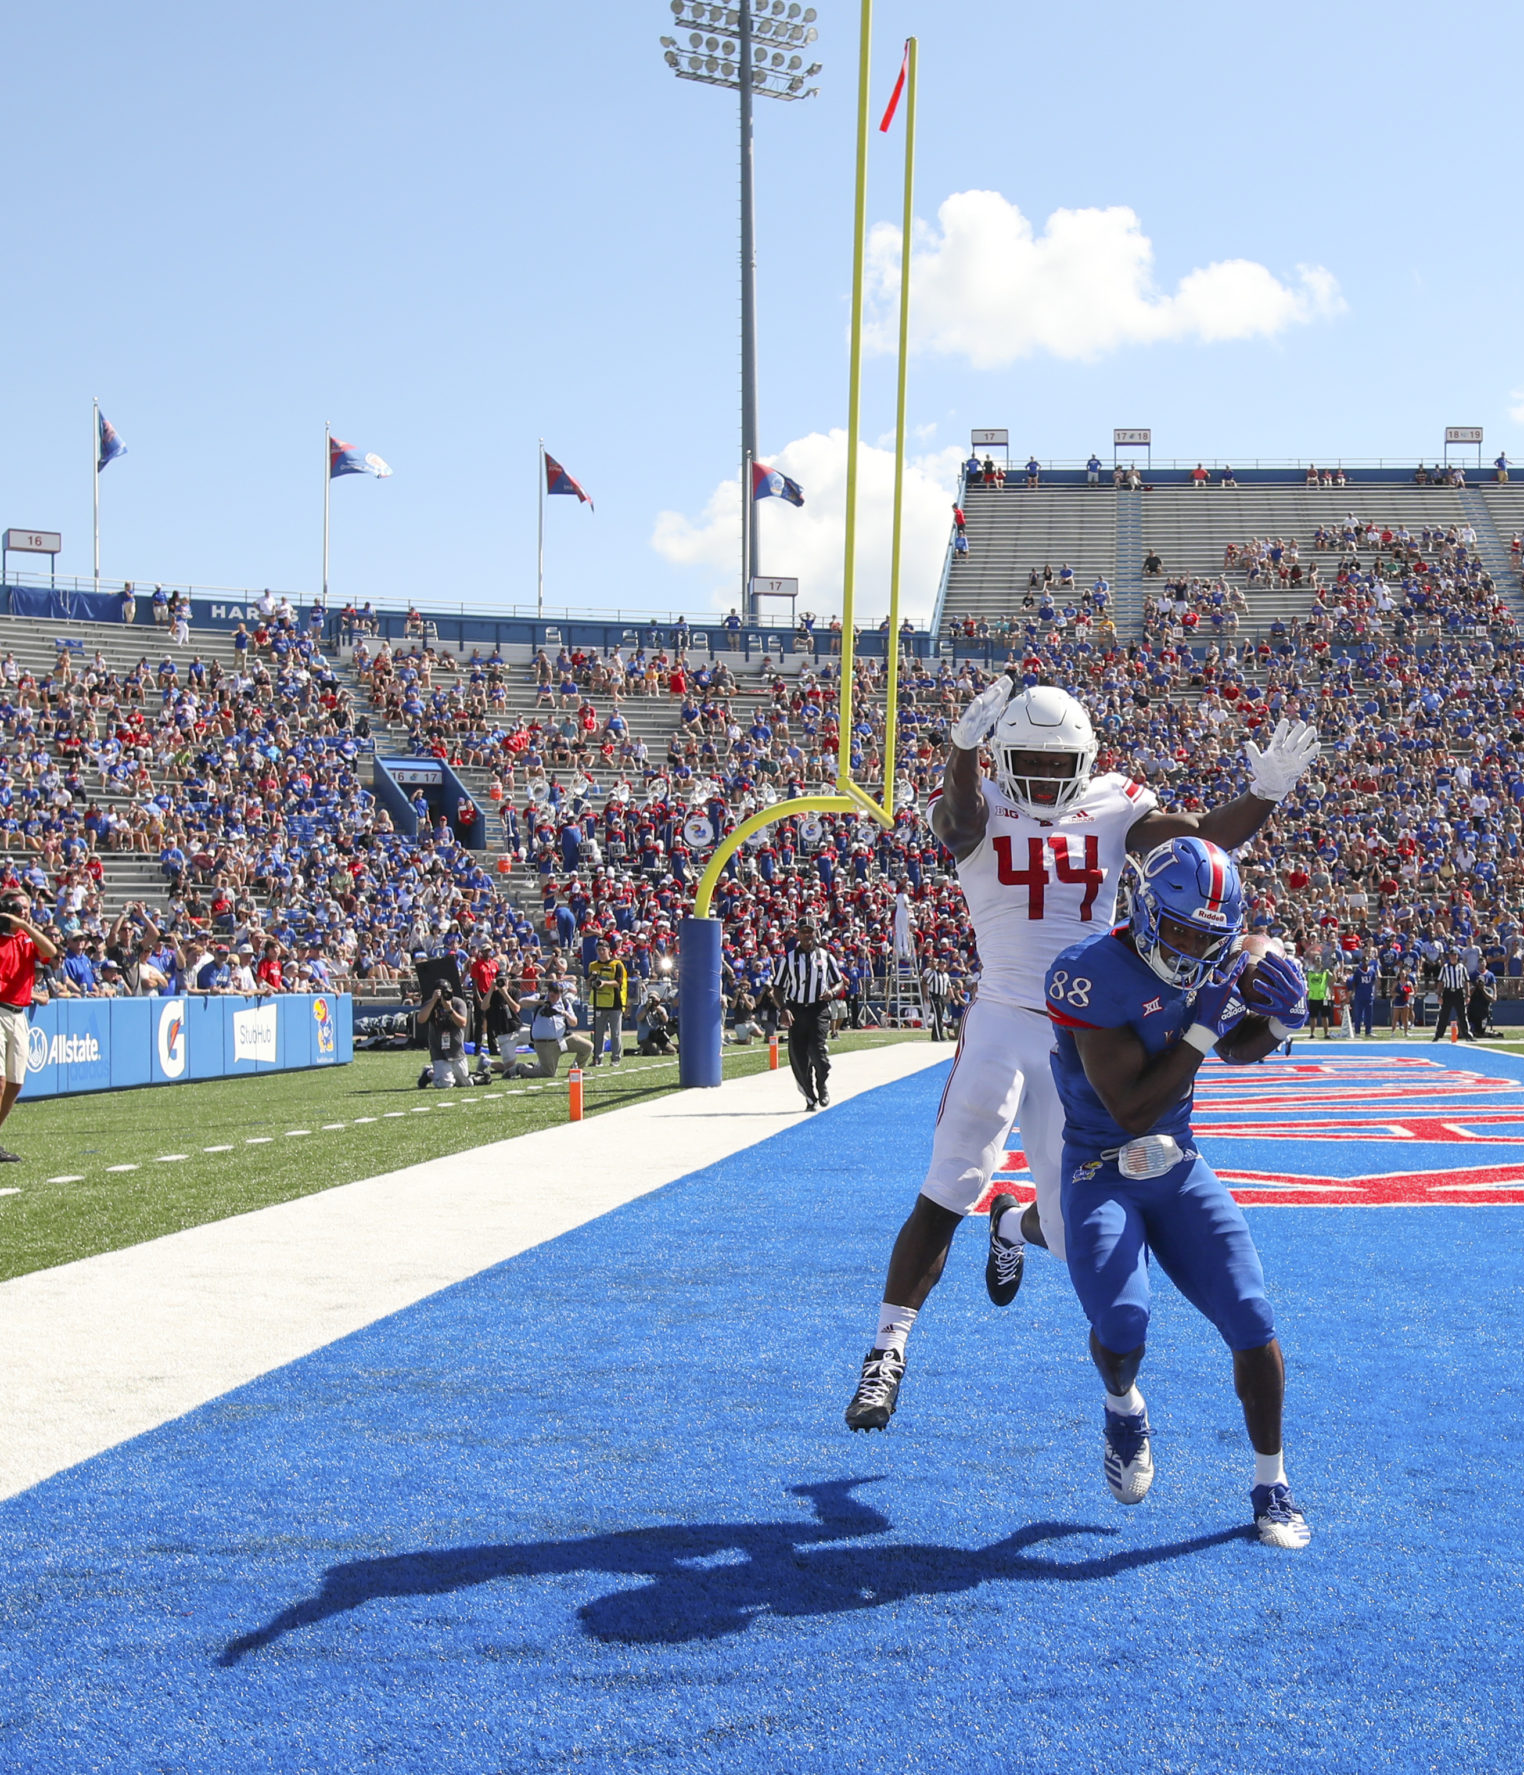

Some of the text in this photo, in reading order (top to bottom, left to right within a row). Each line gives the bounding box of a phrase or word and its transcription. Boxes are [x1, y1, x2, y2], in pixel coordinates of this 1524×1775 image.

[28, 536, 42, 546] 16
[769, 581, 782, 591] 17
[393, 773, 437, 782] 16 17
[992, 835, 1104, 921] 44
[1198, 910, 1225, 922] Riddell
[1049, 970, 1092, 1008] 88
[1221, 1005, 1246, 1020] adidas
[158, 1000, 185, 1078] G
[240, 1025, 271, 1044] StubHub
